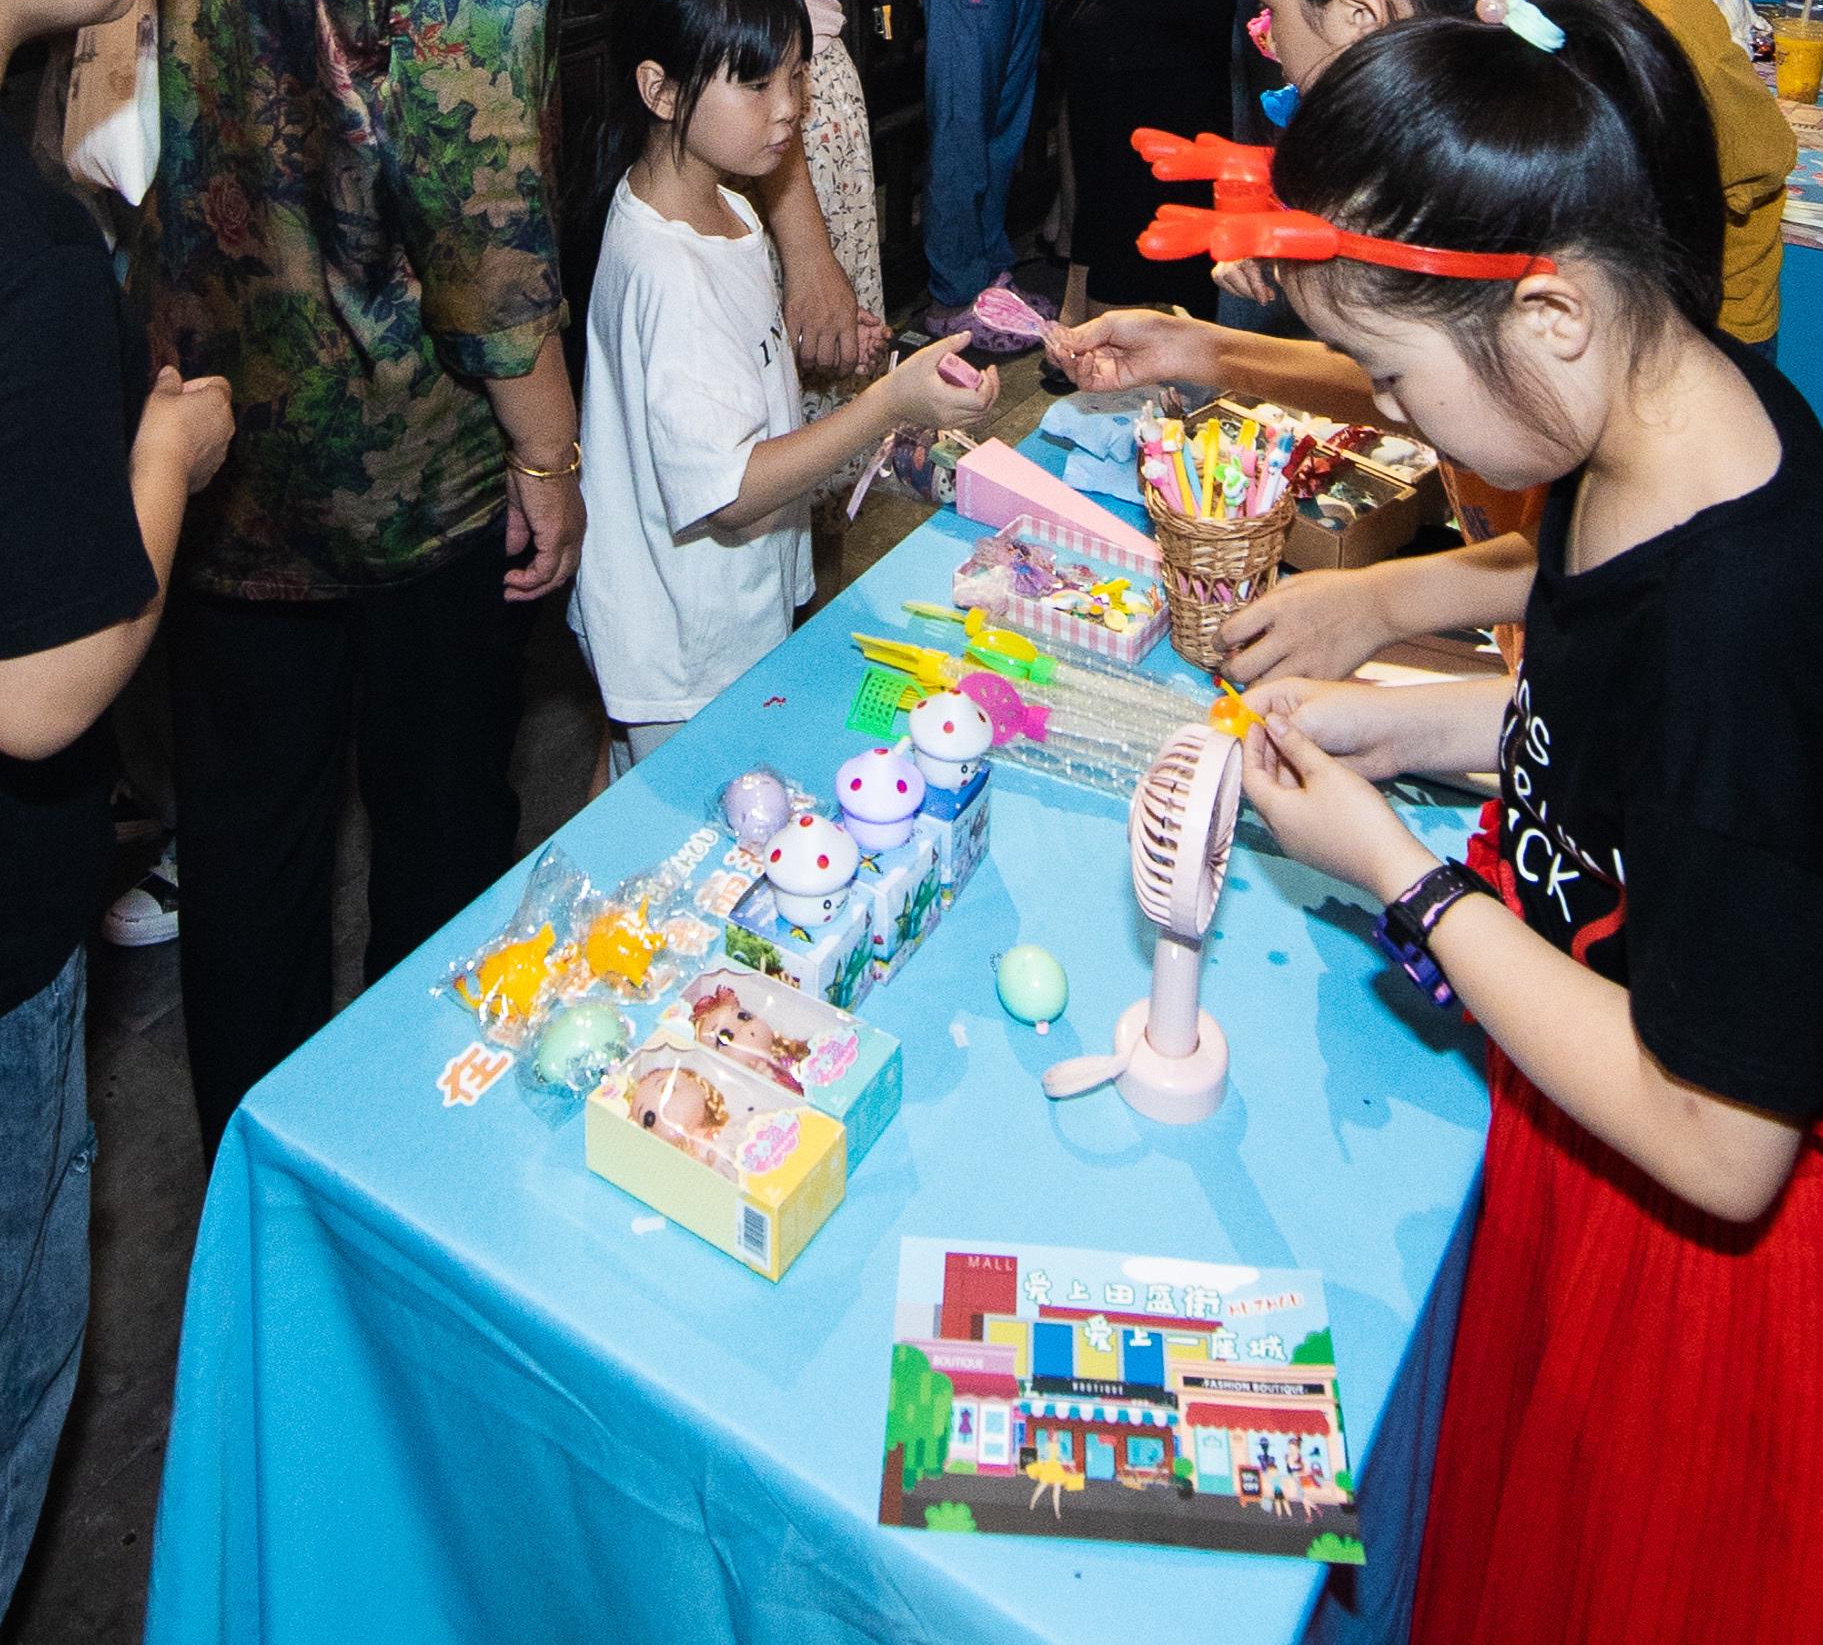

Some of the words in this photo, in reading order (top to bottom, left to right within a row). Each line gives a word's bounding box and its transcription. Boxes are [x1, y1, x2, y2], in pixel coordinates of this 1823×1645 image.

[967, 1256, 1014, 1272] MALL
[1024, 1268, 1221, 1320] 爱上田盛街
[1084, 1312, 1289, 1363] 爱上一座城
